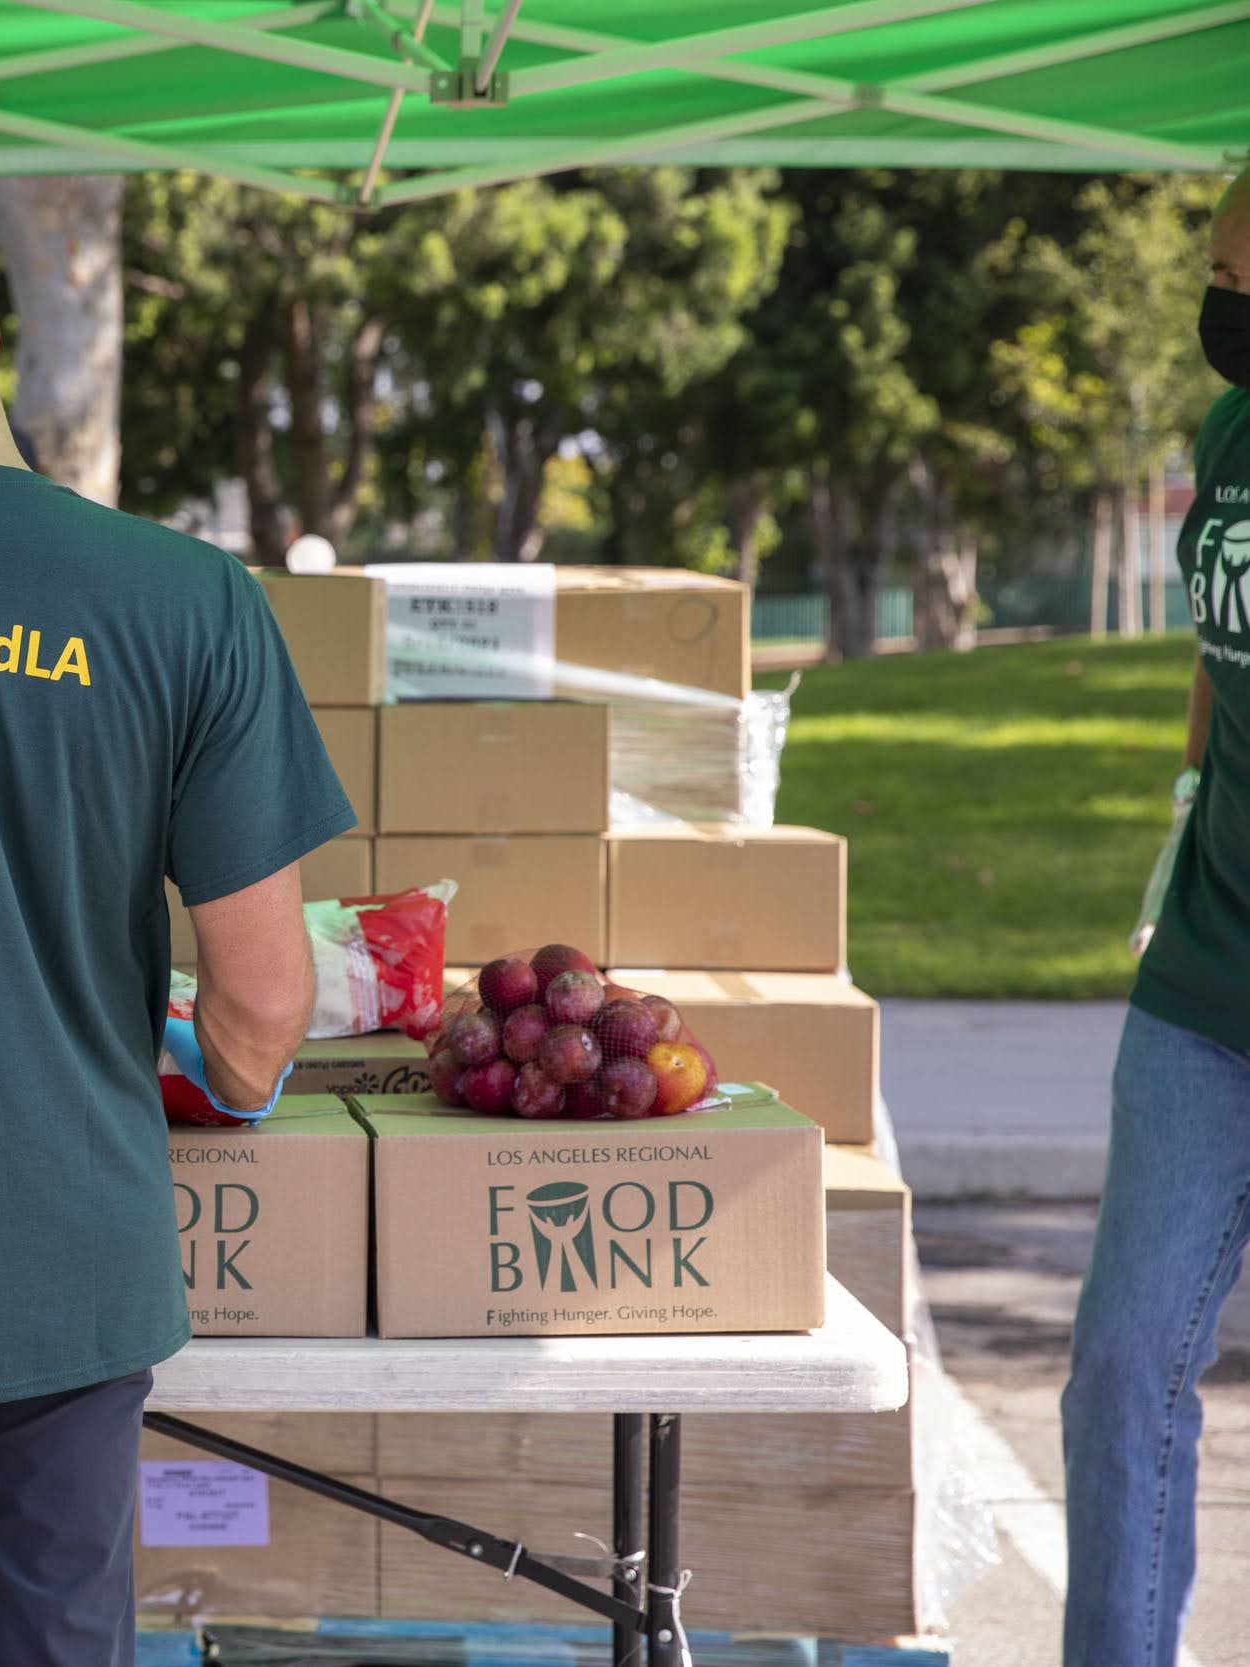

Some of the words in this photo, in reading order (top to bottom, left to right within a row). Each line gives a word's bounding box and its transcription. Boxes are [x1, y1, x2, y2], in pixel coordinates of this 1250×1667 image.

[487, 1149, 523, 1167] LOS
[527, 1147, 612, 1165] ANGELES
[616, 1144, 714, 1163] REGIONAL
[213, 1306, 260, 1325] Hope.
[485, 1308, 549, 1327] Fighting
[552, 1307, 611, 1326] Hunger.
[616, 1304, 668, 1323] Giving
[671, 1303, 718, 1322] Hope.
